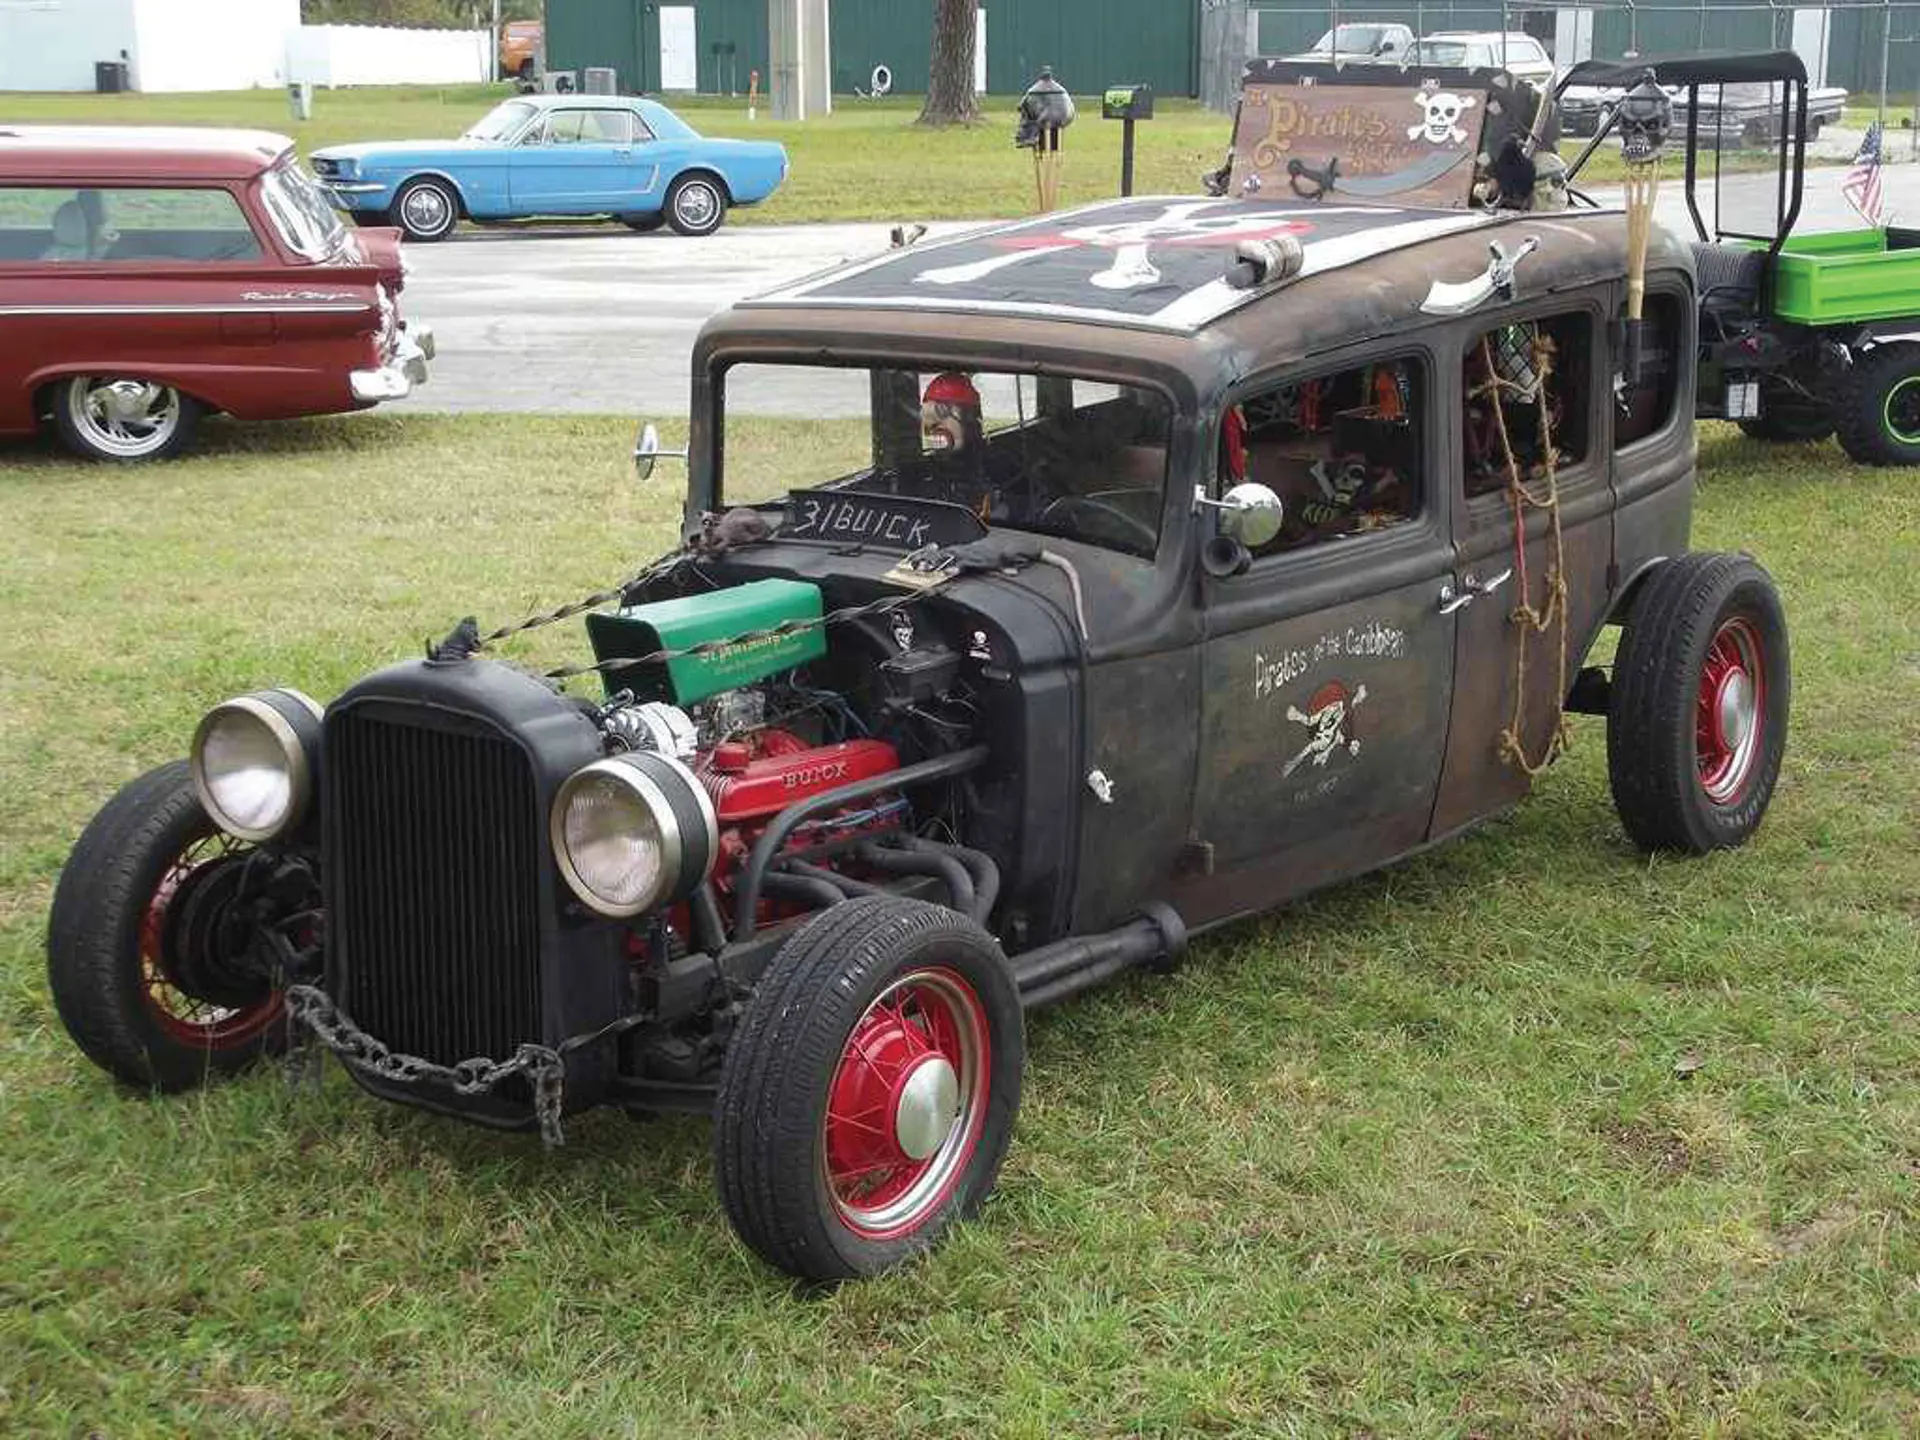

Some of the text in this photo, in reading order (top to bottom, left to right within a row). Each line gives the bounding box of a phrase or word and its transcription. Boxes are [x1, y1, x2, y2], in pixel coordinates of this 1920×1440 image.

[1253, 95, 1389, 169] Pirates
[1255, 650, 1308, 699] Pirates
[782, 761, 850, 789] BUICK
